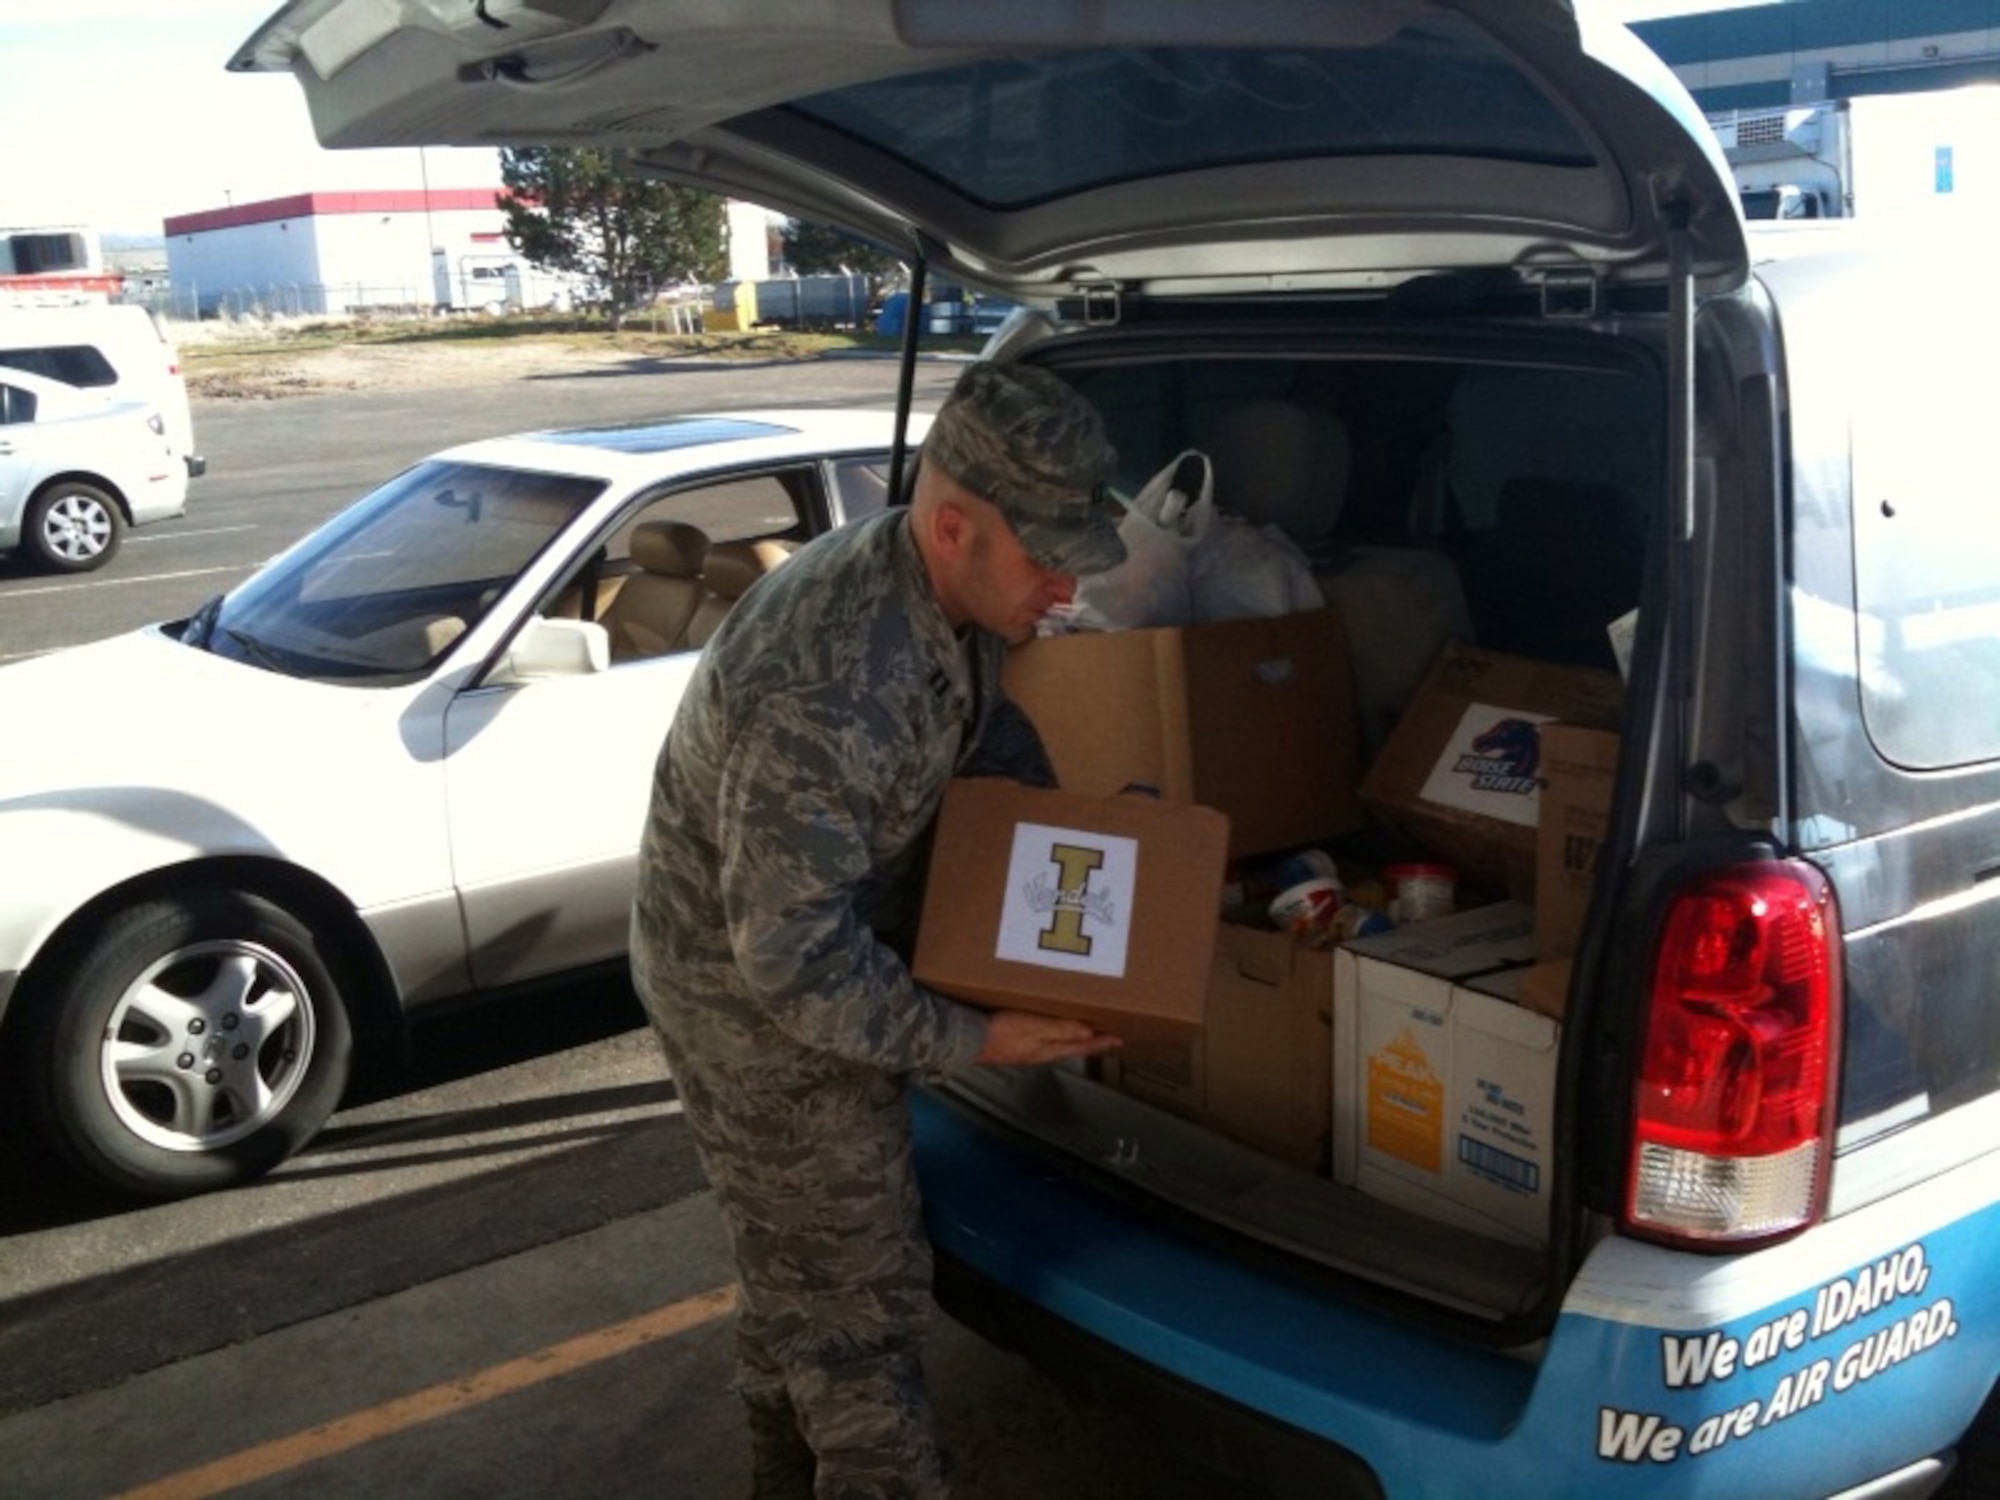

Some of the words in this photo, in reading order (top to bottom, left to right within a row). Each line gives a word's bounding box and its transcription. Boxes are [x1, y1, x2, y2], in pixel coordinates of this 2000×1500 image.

[1456, 757, 1516, 775] BOISE
[1476, 774, 1536, 794] STATE
[1662, 1331, 1738, 1389] We
[1743, 1306, 1808, 1368] are
[1810, 1242, 1931, 1340] IDAHO,
[1597, 1408, 1682, 1463] We
[1688, 1399, 1761, 1456] are
[1761, 1357, 1831, 1427] AIR
[1833, 1297, 1959, 1392] GUARD.
